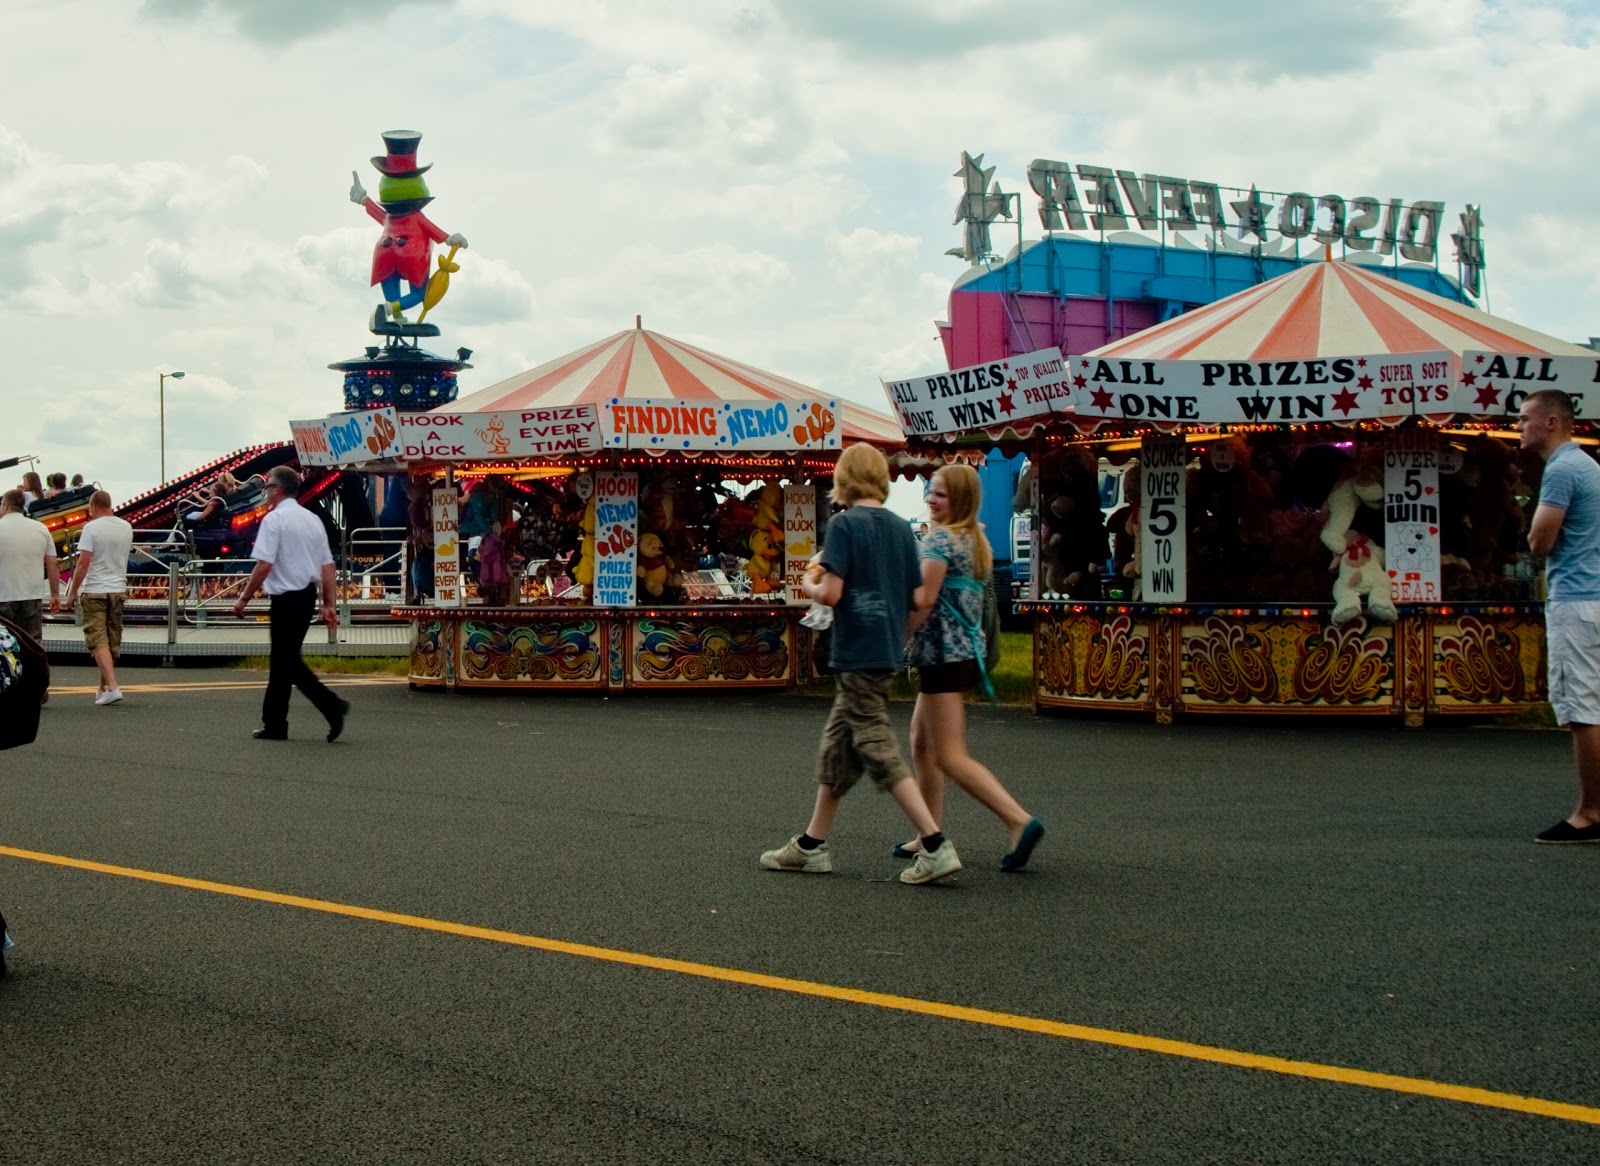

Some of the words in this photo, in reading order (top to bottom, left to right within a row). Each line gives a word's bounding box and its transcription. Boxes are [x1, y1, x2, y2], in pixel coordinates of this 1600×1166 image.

[1015, 367, 1029, 382] TOP
[1032, 358, 1063, 379] QUALITY
[1091, 359, 1165, 386] ALL
[1200, 358, 1356, 387] PRIZES
[1379, 363, 1414, 383] SUPER
[1421, 360, 1448, 380] SOFT
[1482, 354, 1558, 382] ALL
[893, 381, 918, 404] ALL
[925, 363, 1005, 400] PRIZES
[1022, 380, 1072, 405] PRIZES
[1380, 384, 1449, 406] TOYS
[1120, 393, 1200, 419] ONE
[1236, 394, 1326, 420] WIN
[1505, 390, 1584, 416] OE
[400, 415, 464, 428] HOOK
[520, 406, 591, 423] PRIZE
[911, 410, 938, 433] ONE
[948, 399, 997, 429] WIN
[519, 421, 596, 438] EVERY
[611, 404, 717, 437] FINDING
[725, 402, 789, 447] NEMO
[292, 426, 328, 453] FINDING
[328, 417, 363, 461] NEMO
[427, 430, 442, 441] A
[406, 445, 466, 457] DUCK
[530, 437, 591, 453] TIME
[1143, 442, 1184, 468] SCORE
[1386, 451, 1437, 468] OVER
[596, 478, 637, 496] HOOK
[1147, 471, 1180, 497] OVER
[1404, 469, 1422, 501] 5
[434, 494, 458, 507] HOOK
[785, 493, 815, 505] HOOK
[1388, 493, 1404, 504] TO
[442, 507, 449, 519] A
[596, 500, 637, 528] NEMO
[794, 506, 804, 518] A
[1148, 497, 1178, 537] 5
[435, 521, 458, 533] DUCK
[786, 520, 814, 532] DUCK
[1154, 539, 1172, 565] TO
[436, 561, 457, 573] PRIZE
[600, 560, 632, 575] PRIZE
[787, 560, 809, 571] PRIZ
[435, 575, 459, 587] EVERY
[597, 575, 633, 590] EVERY
[786, 574, 804, 586] EVE
[1152, 568, 1174, 595] WIN
[438, 589, 455, 601] TIME
[599, 591, 628, 605] TIME
[791, 588, 811, 600] TIM
[1391, 582, 1438, 601] BEAR
